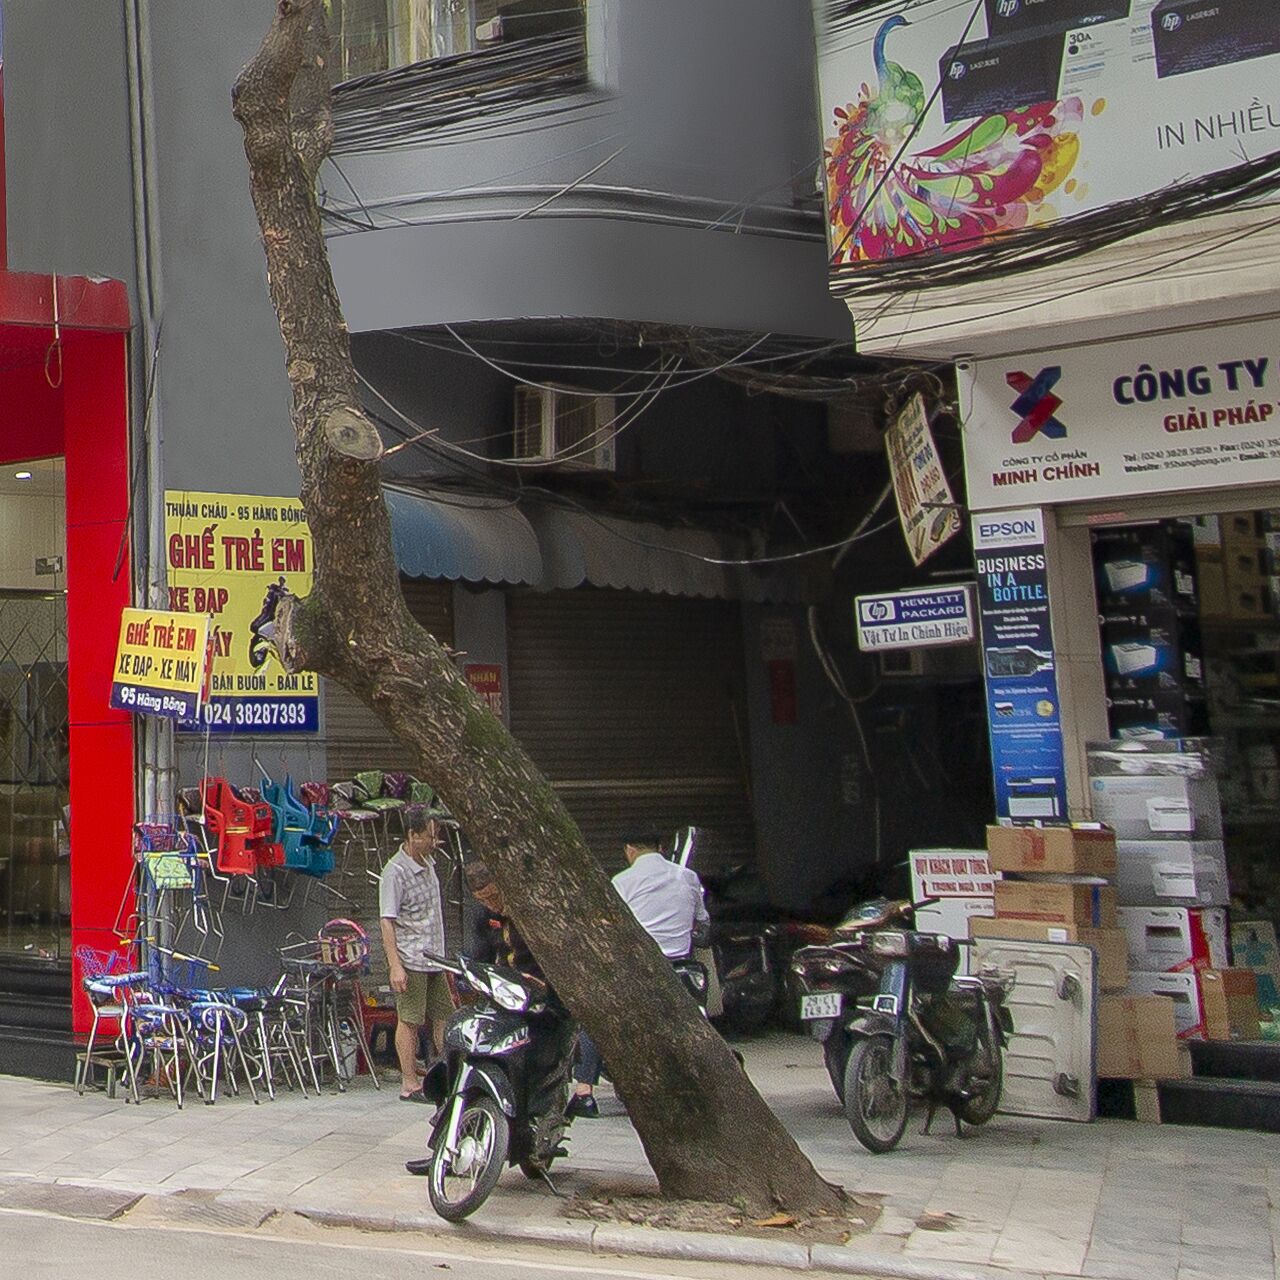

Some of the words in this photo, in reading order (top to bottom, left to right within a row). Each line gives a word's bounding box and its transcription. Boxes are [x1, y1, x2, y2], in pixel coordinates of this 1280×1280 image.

[1069, 32, 1092, 46] 30A
[1156, 122, 1185, 149] IN
[1112, 363, 1212, 405] CÔNG
[1218, 357, 1269, 391] TY
[1163, 406, 1208, 433] GIẢI
[1213, 399, 1273, 426] PHÁP
[992, 468, 1038, 487] MINH
[1042, 460, 1101, 481] CHÍNH
[201, 501, 228, 520] CHÂU
[237, 507, 250, 521] 95
[253, 505, 278, 522] HÀNG
[280, 506, 307, 523] BÔNG
[979, 519, 1036, 538] EPSON
[169, 523, 218, 570] GHẾ
[221, 528, 265, 571] TRẺ
[271, 537, 306, 572] EM
[977, 554, 1045, 574] BUSINESS
[987, 573, 1002, 588] IN
[1006, 572, 1016, 586] A
[168, 586, 190, 612] XE
[193, 587, 229, 618] ĐẠP
[899, 593, 961, 608] HEWLETT
[993, 584, 1049, 602] BOTTLE.
[901, 605, 965, 619] PACKARD
[126, 617, 153, 647] GHẾ
[153, 619, 175, 650] TRẺ
[178, 627, 198, 652] EM
[863, 629, 880, 646] Vật
[882, 627, 897, 642] Tư
[911, 623, 942, 640] Chính
[944, 621, 969, 638] Hiệu
[118, 652, 133, 675] XE
[132, 656, 153, 681] ĐẠP
[160, 658, 174, 680] XE
[175, 658, 198, 684] MÁY
[212, 671, 233, 690] BÁN
[120, 686, 135, 705] 95
[136, 691, 162, 712] Hàng
[162, 694, 187, 716] Bông
[204, 703, 232, 724] 024
[235, 702, 306, 724] 38287393
